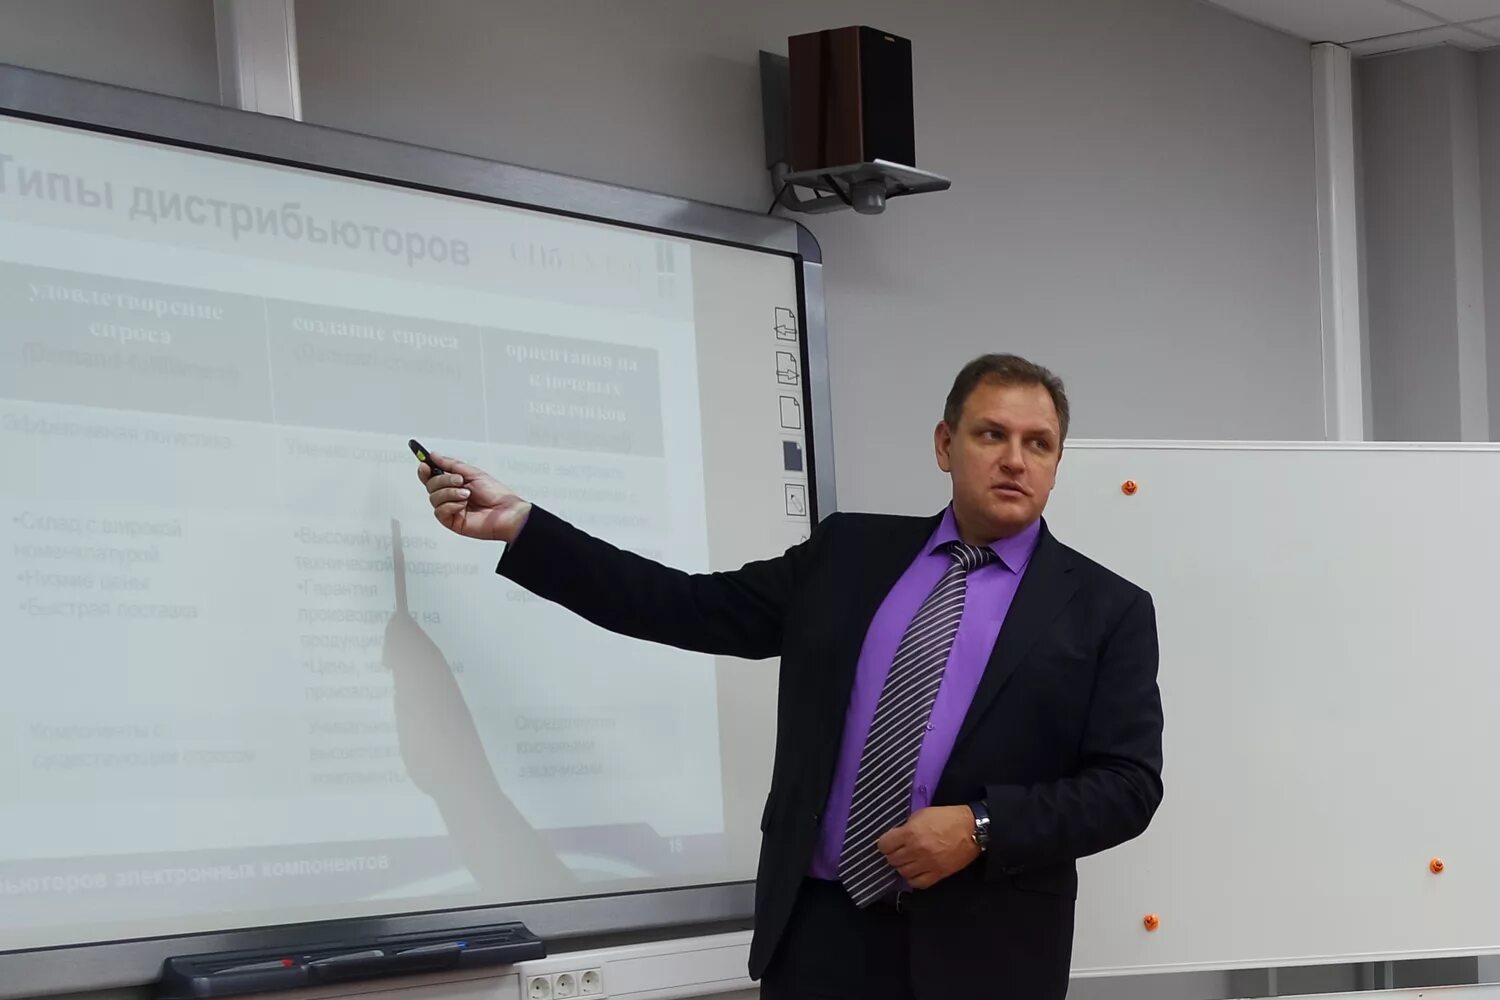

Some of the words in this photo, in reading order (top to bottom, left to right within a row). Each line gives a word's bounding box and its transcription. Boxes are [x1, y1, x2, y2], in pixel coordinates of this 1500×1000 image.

[0, 153, 115, 211] Типы
[129, 185, 472, 268] дистрибьюторов
[27, 279, 225, 322] удовлетворение
[88, 320, 174, 347] спроса
[291, 316, 387, 343] создание
[391, 327, 461, 353] спроса
[616, 357, 639, 374] на
[374, 532, 438, 552] урвень
[399, 560, 480, 579] оддержки
[115, 861, 257, 890] электронных
[261, 852, 391, 879] компонентов
